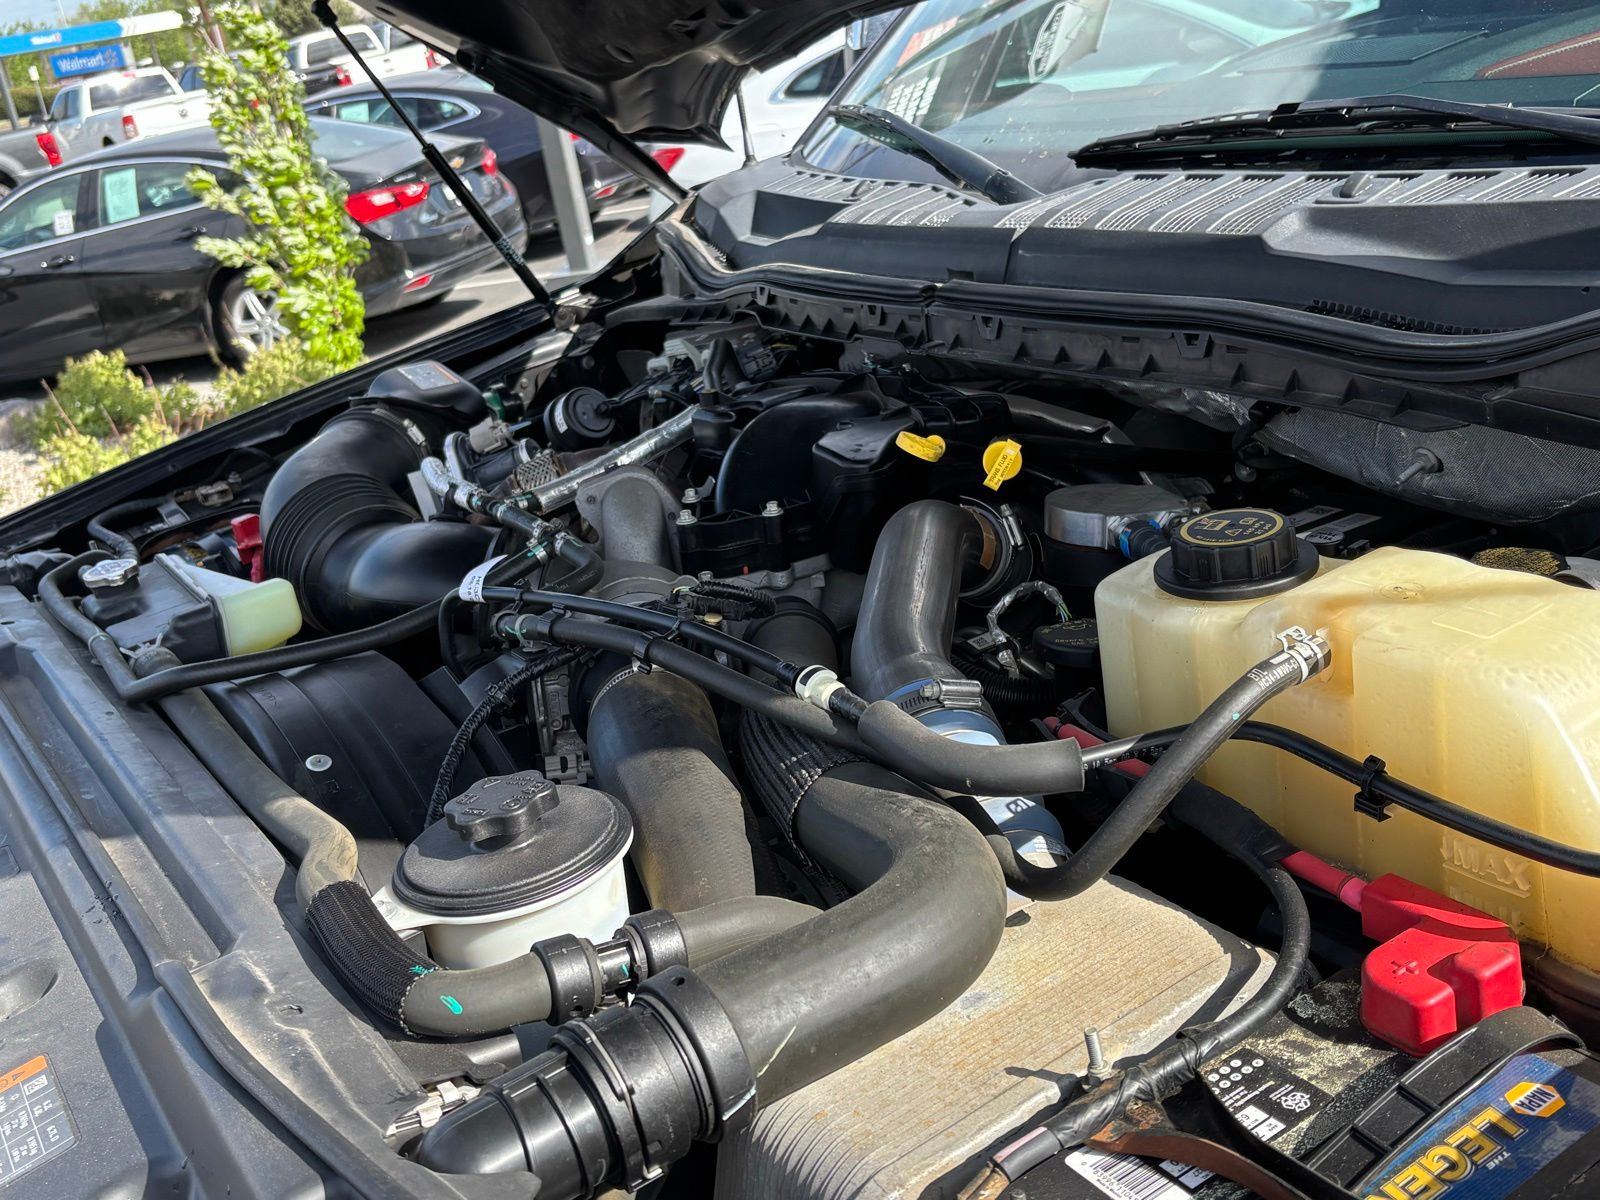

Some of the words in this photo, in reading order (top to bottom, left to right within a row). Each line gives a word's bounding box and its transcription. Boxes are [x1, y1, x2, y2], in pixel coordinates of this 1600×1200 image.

[57, 52, 105, 73] Walmart
[1453, 839, 1532, 891] MAX
[1515, 1086, 1555, 1112] NAPA
[1486, 1151, 1511, 1171] THE
